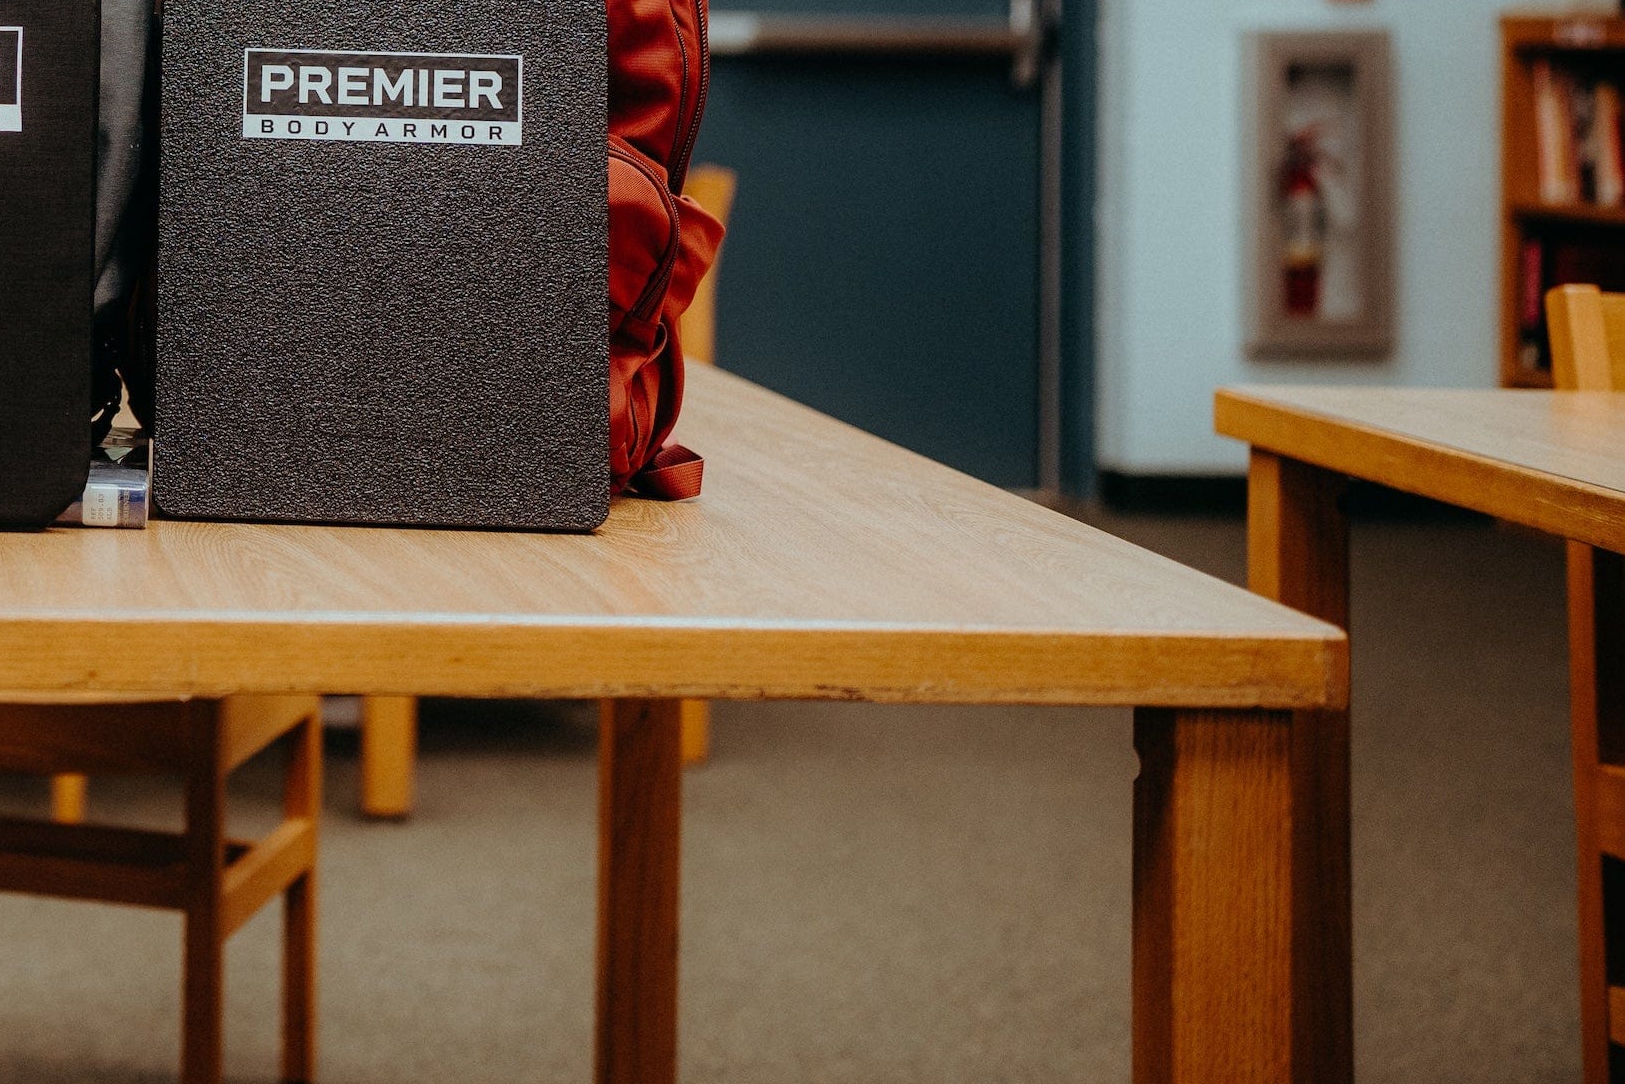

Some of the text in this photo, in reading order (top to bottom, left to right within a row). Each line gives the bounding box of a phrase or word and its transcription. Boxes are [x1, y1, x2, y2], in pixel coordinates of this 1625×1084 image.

[260, 64, 504, 110] PREMIER
[260, 119, 503, 140] BODY ARMOR
